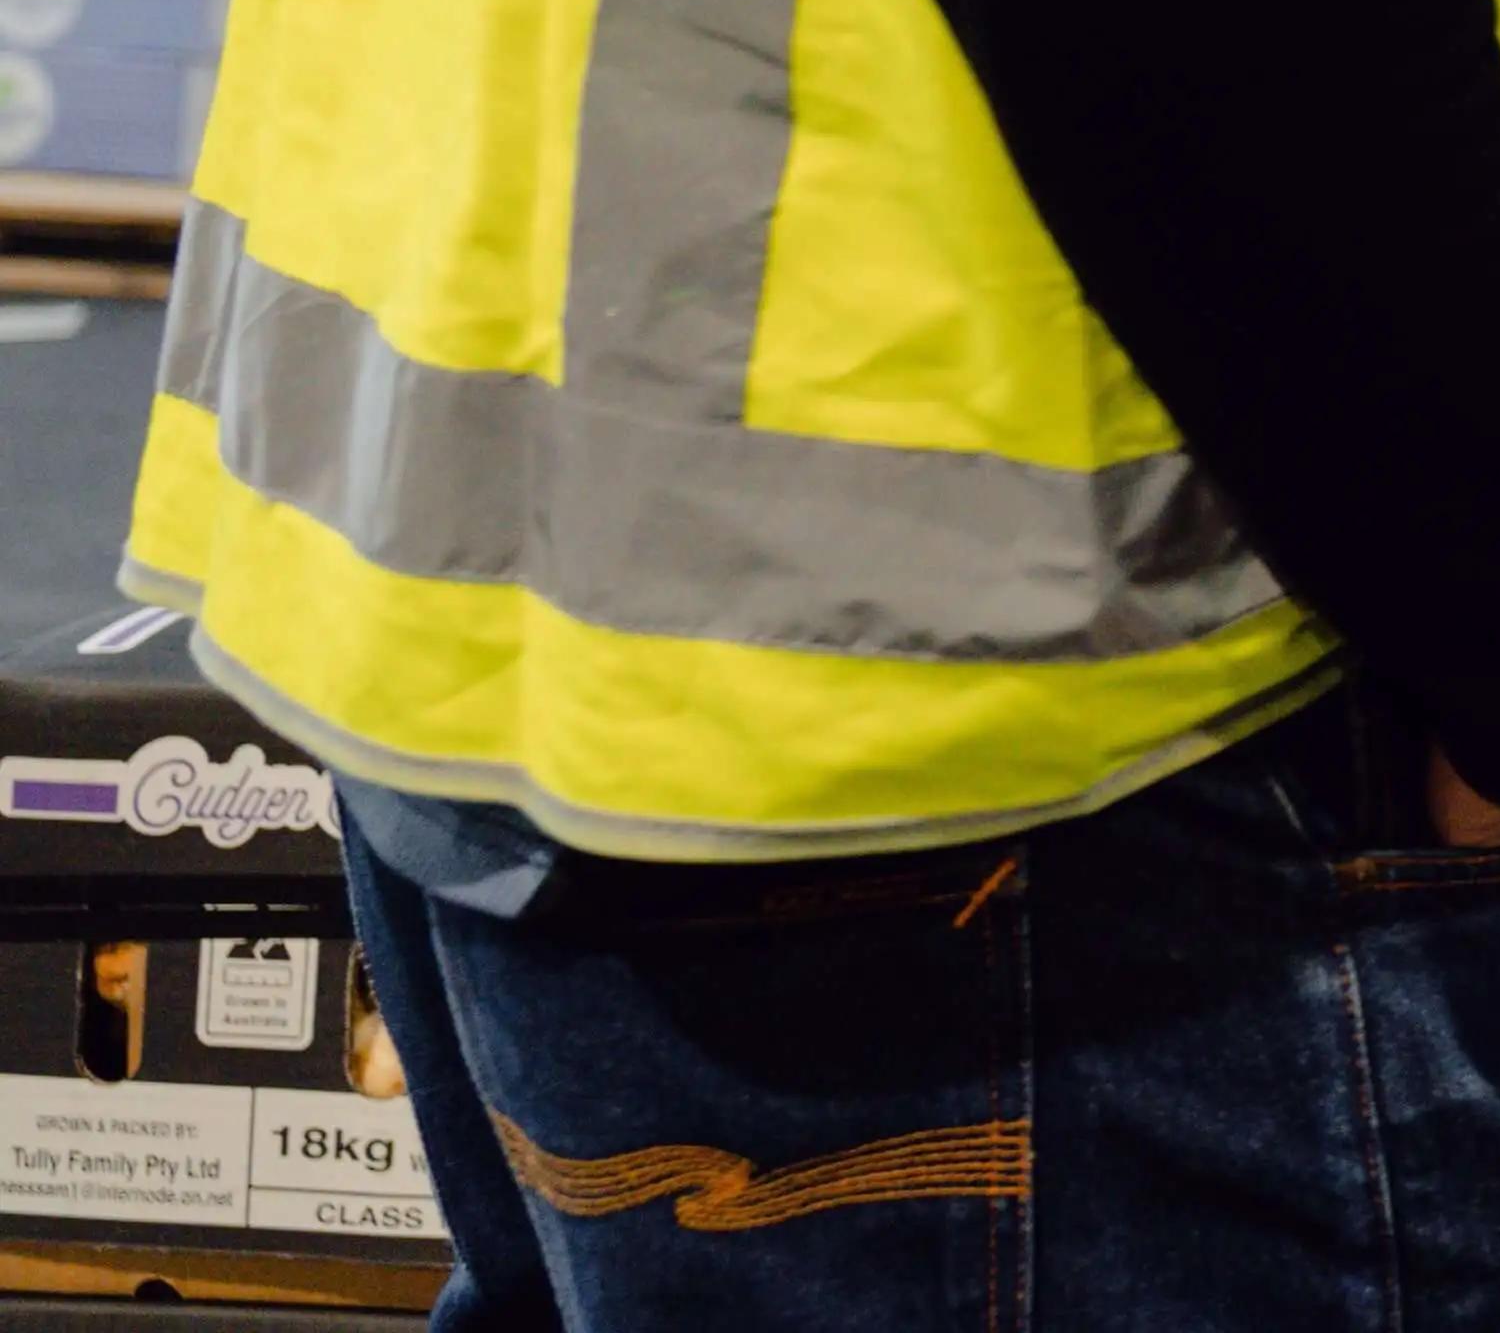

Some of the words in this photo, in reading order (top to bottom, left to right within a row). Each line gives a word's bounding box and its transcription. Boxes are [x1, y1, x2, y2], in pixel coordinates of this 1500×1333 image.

[13, 1146, 62, 1176] Tully
[67, 1148, 138, 1183] Family
[145, 1154, 181, 1184] Pty
[185, 1157, 221, 1181] Ltd
[272, 1124, 396, 1173] 18kg
[315, 1201, 424, 1230] CLASS
